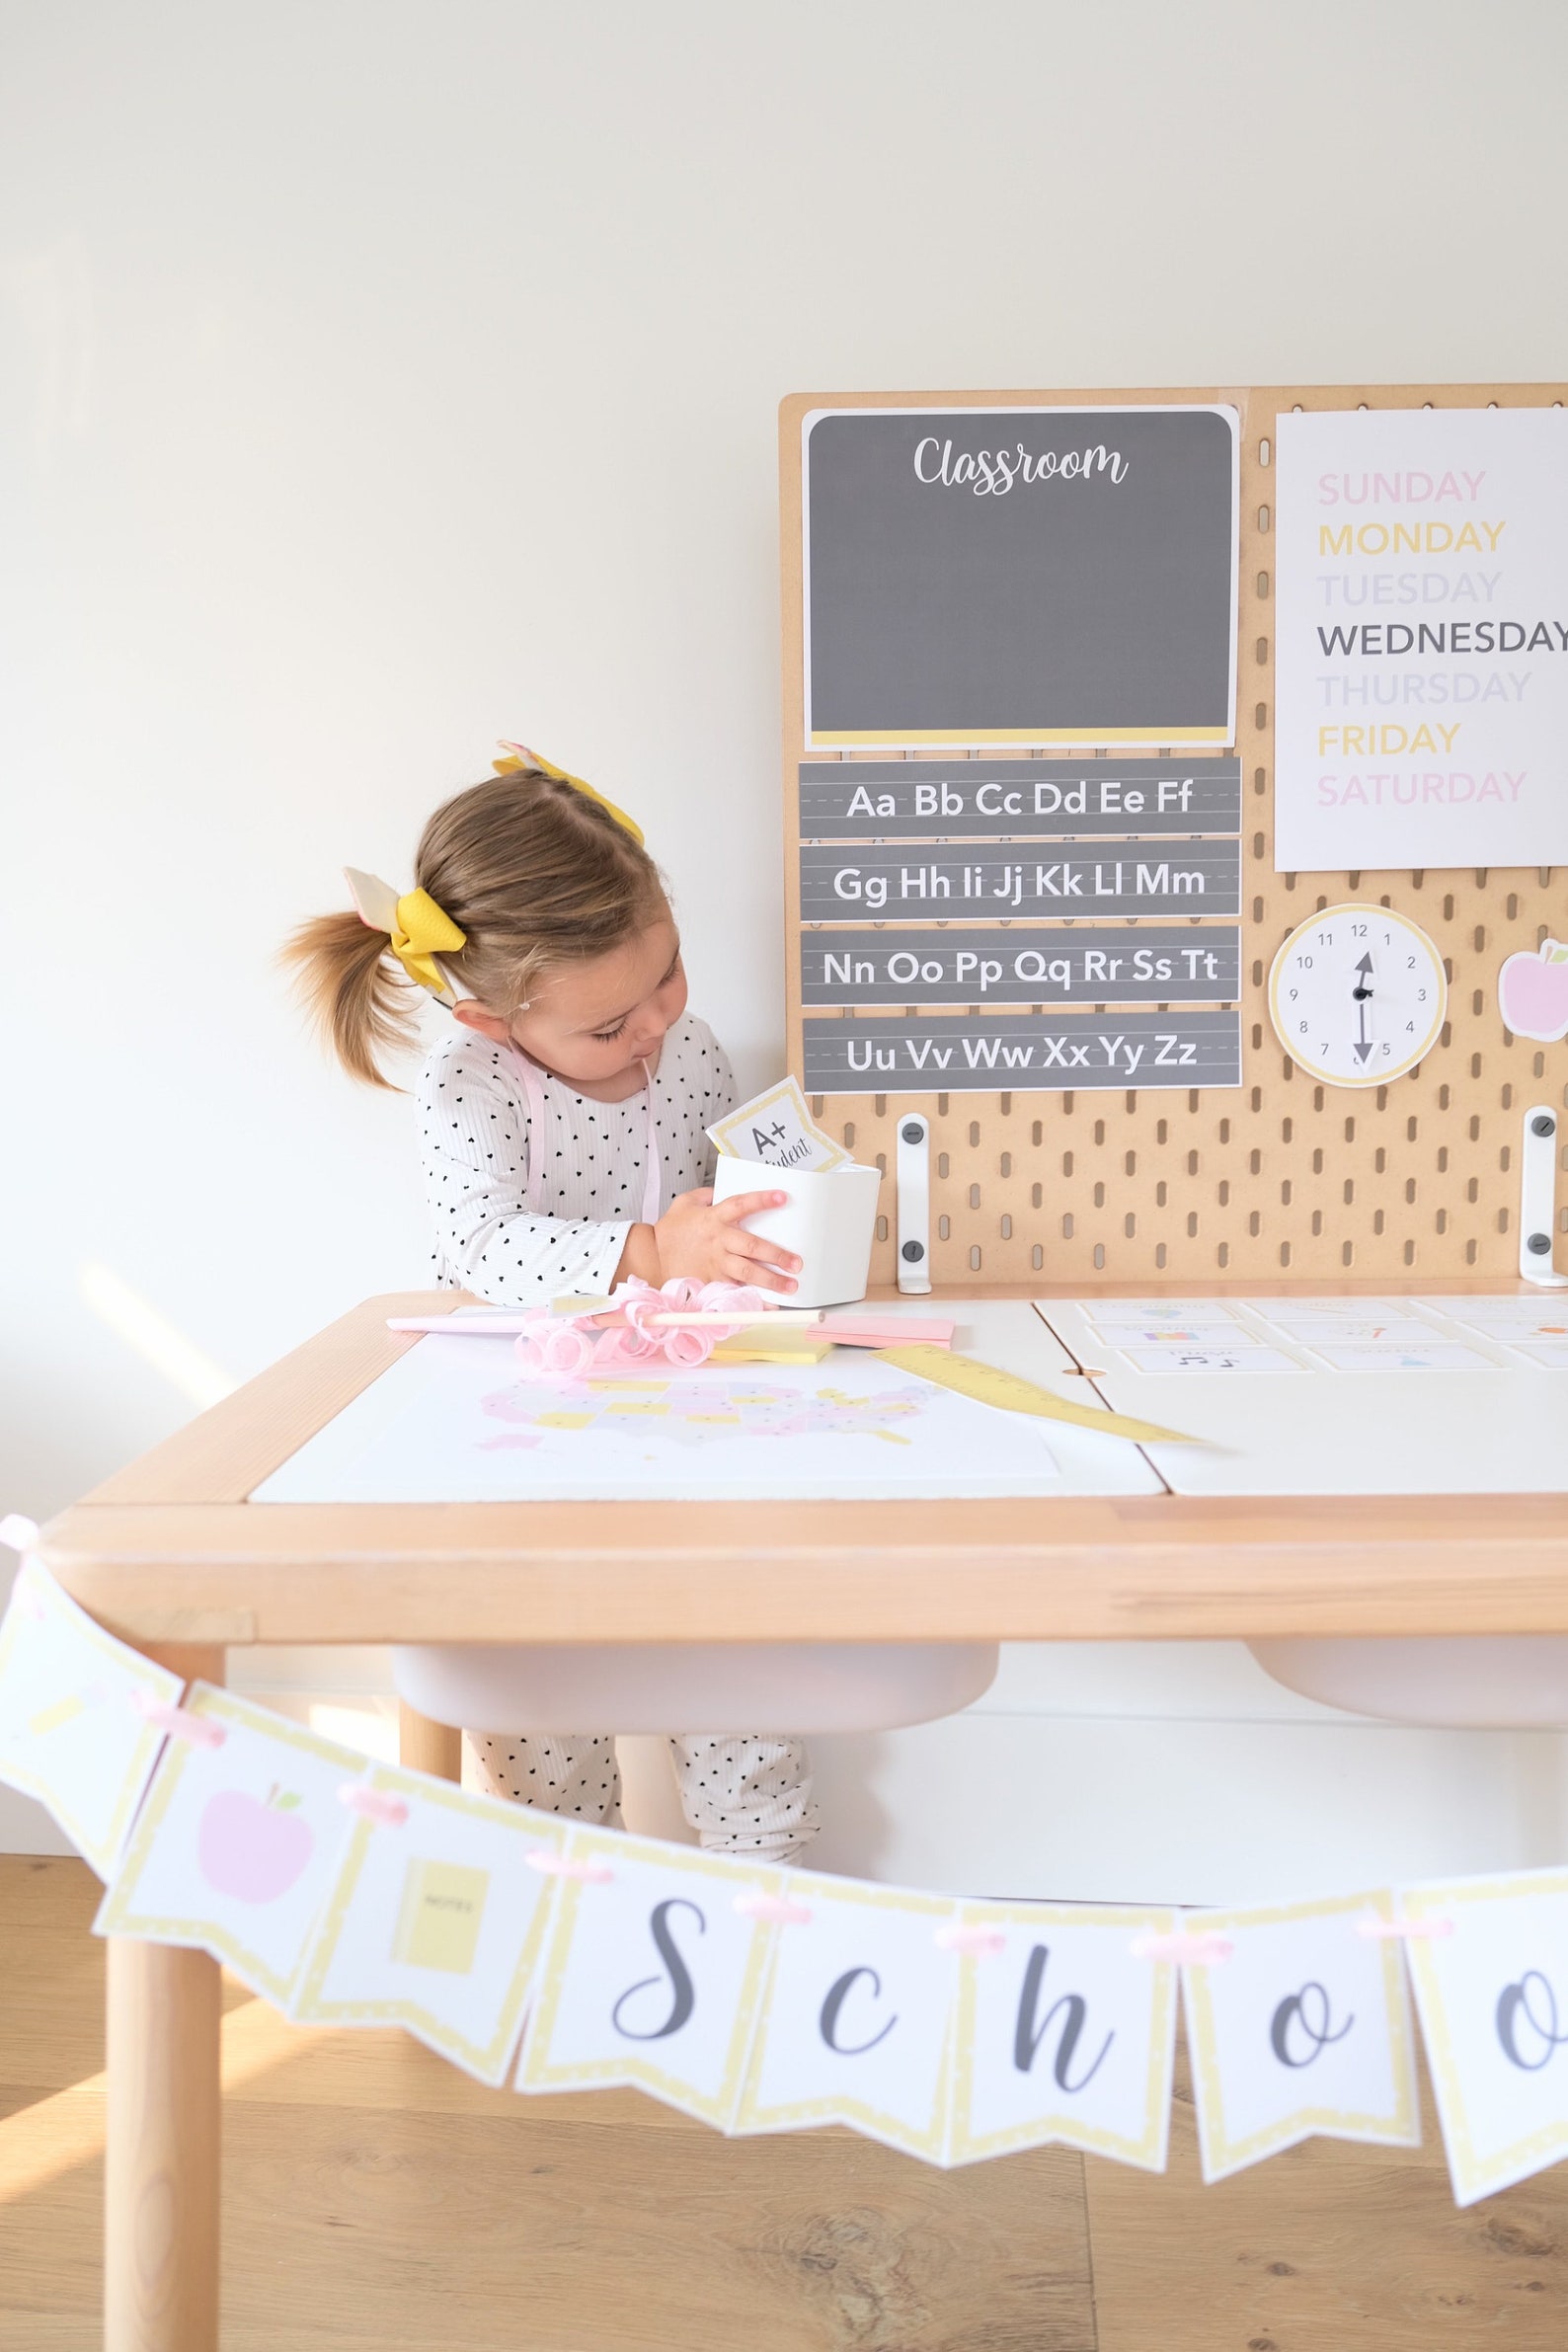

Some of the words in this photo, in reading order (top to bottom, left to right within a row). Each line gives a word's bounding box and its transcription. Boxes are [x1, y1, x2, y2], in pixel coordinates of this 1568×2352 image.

[913, 437, 1130, 496] Classroom
[1318, 470, 1487, 506] SUNDAY
[1319, 520, 1507, 556] MONDAY
[1316, 571, 1503, 606] TUESDAY
[1316, 621, 1568, 657] WEDNESDAY
[1316, 671, 1533, 707] THURSDAY
[1318, 722, 1461, 756] FRIDAY
[846, 786, 896, 818] Aa
[915, 782, 964, 816] Bb
[976, 783, 1022, 816] Cc
[1034, 780, 1086, 815] Dd
[1100, 782, 1144, 814] Ee
[1157, 778, 1194, 813] Ff
[1316, 771, 1529, 808] SATURDAY
[833, 868, 888, 908] Gg
[901, 865, 950, 899] Hh
[993, 865, 1023, 906] Jj
[1036, 863, 1083, 897] Kk
[1137, 863, 1205, 895] Mm
[1318, 933, 1333, 946] 11
[1351, 924, 1368, 937] 12
[1383, 933, 1390, 946] 1
[823, 953, 875, 983] Nn
[887, 952, 944, 983] Oo
[956, 952, 1003, 991] Pp
[1014, 950, 1070, 990] Qq
[1084, 950, 1123, 981] Rr
[1133, 949, 1172, 981] Ss
[1181, 949, 1218, 980] Tt
[1296, 956, 1313, 970] 10
[1407, 956, 1416, 969] 2
[1290, 988, 1298, 1001] 9
[1418, 988, 1427, 1002] 3
[1299, 1020, 1308, 1034] 8
[1405, 1020, 1415, 1033] 4
[847, 1040, 896, 1071] Uu
[905, 1039, 953, 1069] Vv
[962, 1038, 1034, 1068] Ww
[1043, 1037, 1091, 1067] Xx
[1098, 1036, 1144, 1075] Yy
[1154, 1035, 1197, 1065] Zz
[1320, 1043, 1329, 1056] 7
[1381, 1043, 1391, 1056] 5
[751, 1122, 786, 1155] A+
